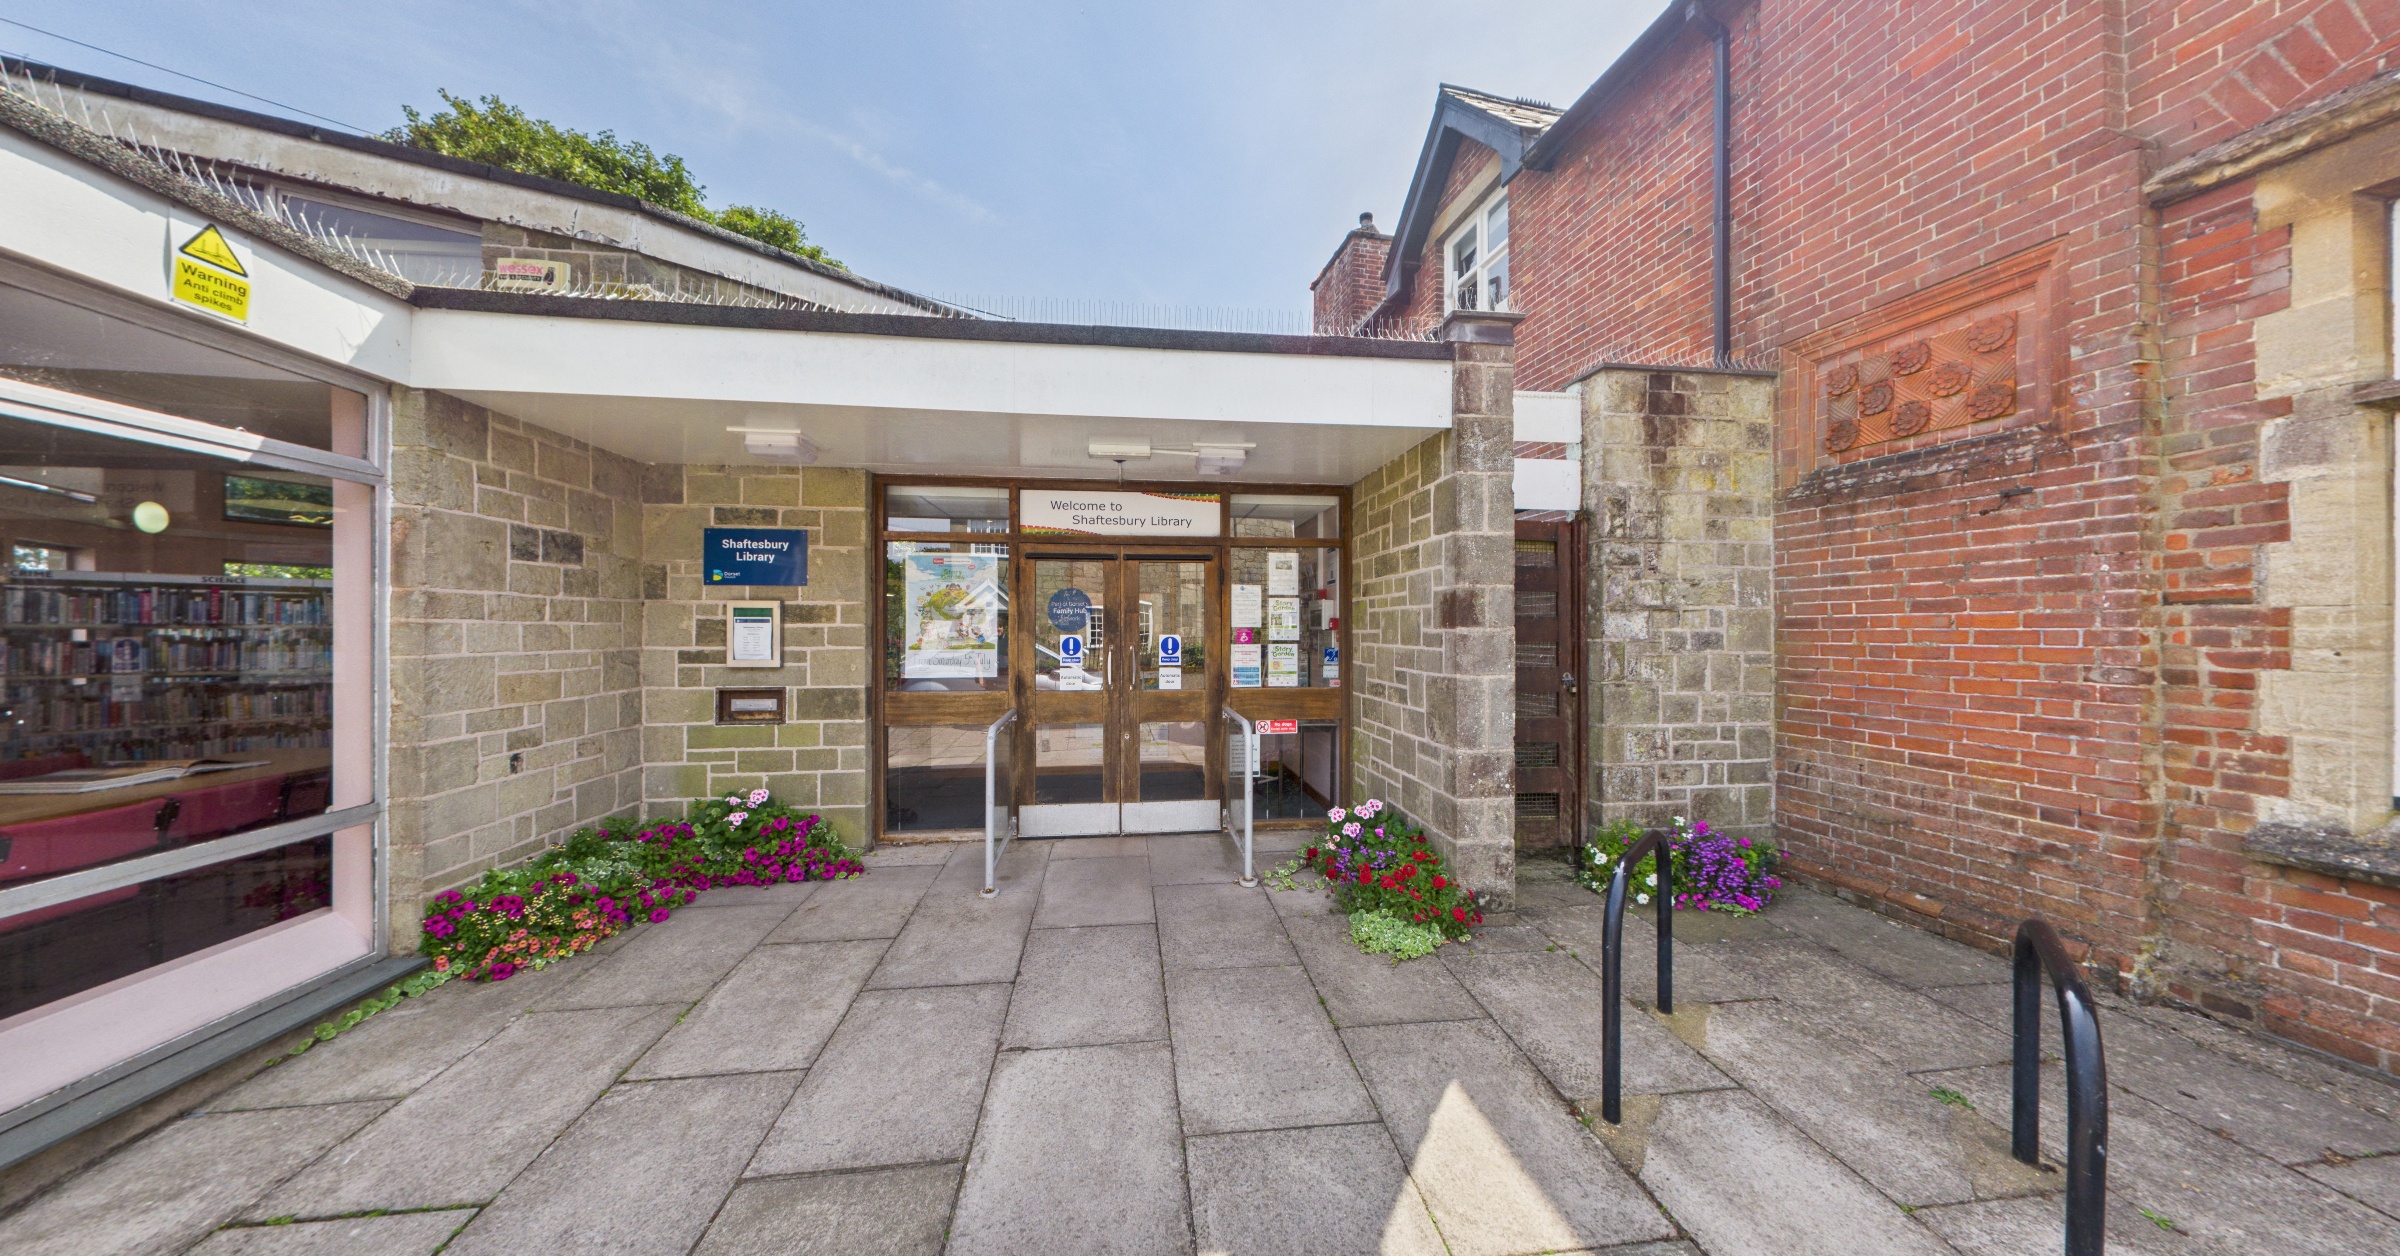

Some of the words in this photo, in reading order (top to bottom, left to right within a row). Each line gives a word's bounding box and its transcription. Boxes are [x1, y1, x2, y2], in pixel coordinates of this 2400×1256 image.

[499, 265, 543, 275] wessex
[181, 262, 247, 297] Warning
[184, 279, 208, 292] Anti
[212, 290, 243, 305] climb
[194, 293, 232, 310] spikes
[1050, 500, 1106, 511] Welcome
[1110, 502, 1122, 511] to
[1072, 514, 1147, 528] Shaftesbury
[1151, 516, 1192, 528] Library
[722, 539, 789, 551] Shaftesbury
[736, 552, 775, 564] Library
[201, 576, 247, 584] SCIENCE
[1053, 607, 1073, 615] Family
[973, 653, 991, 670] July
